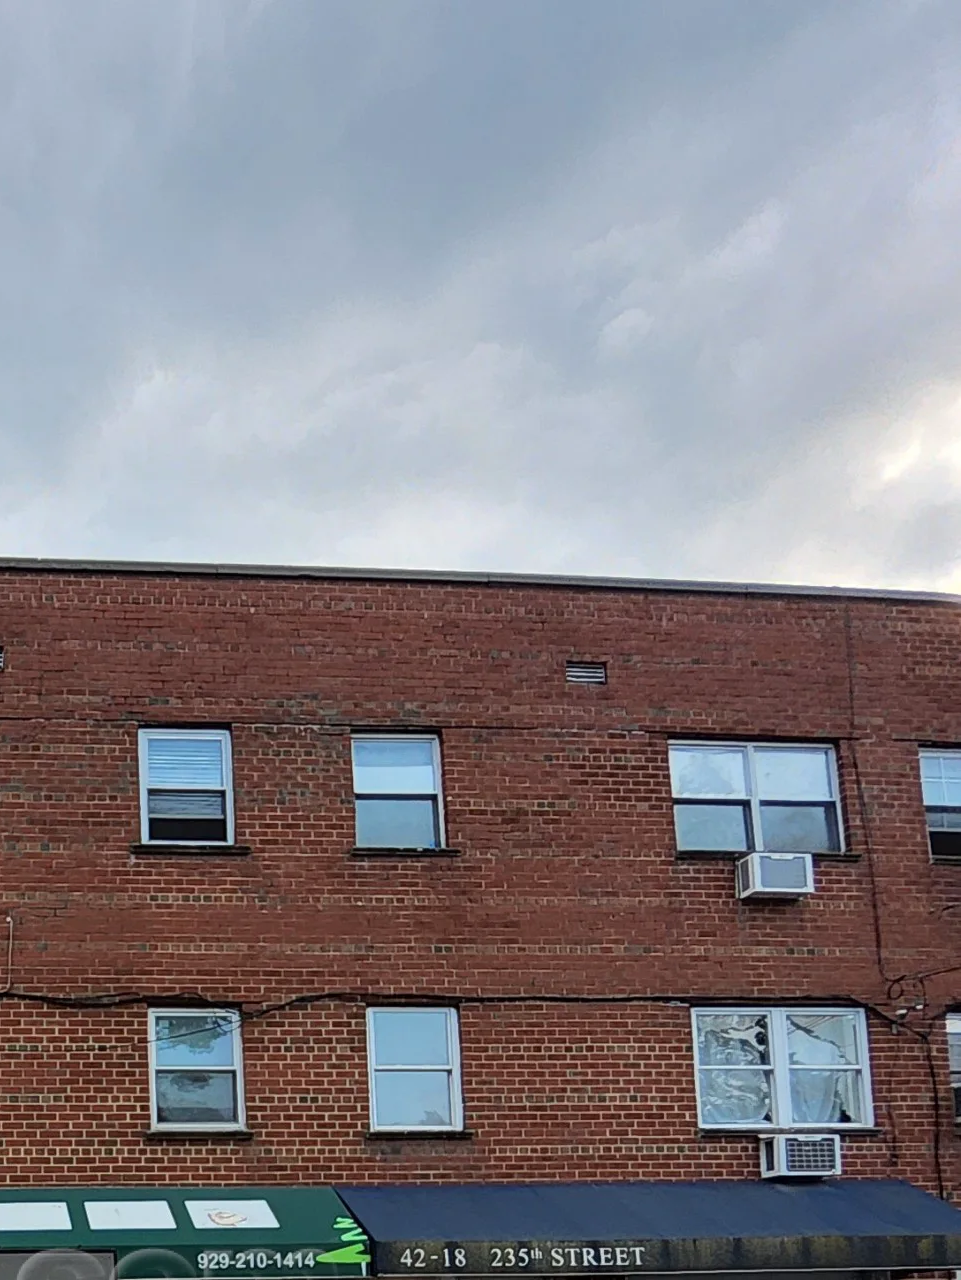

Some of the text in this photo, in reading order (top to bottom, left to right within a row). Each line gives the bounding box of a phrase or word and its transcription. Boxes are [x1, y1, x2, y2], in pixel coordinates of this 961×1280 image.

[197, 1252, 315, 1269] 929-210-1414
[400, 1247, 645, 1267] 42-18 235th STREET
